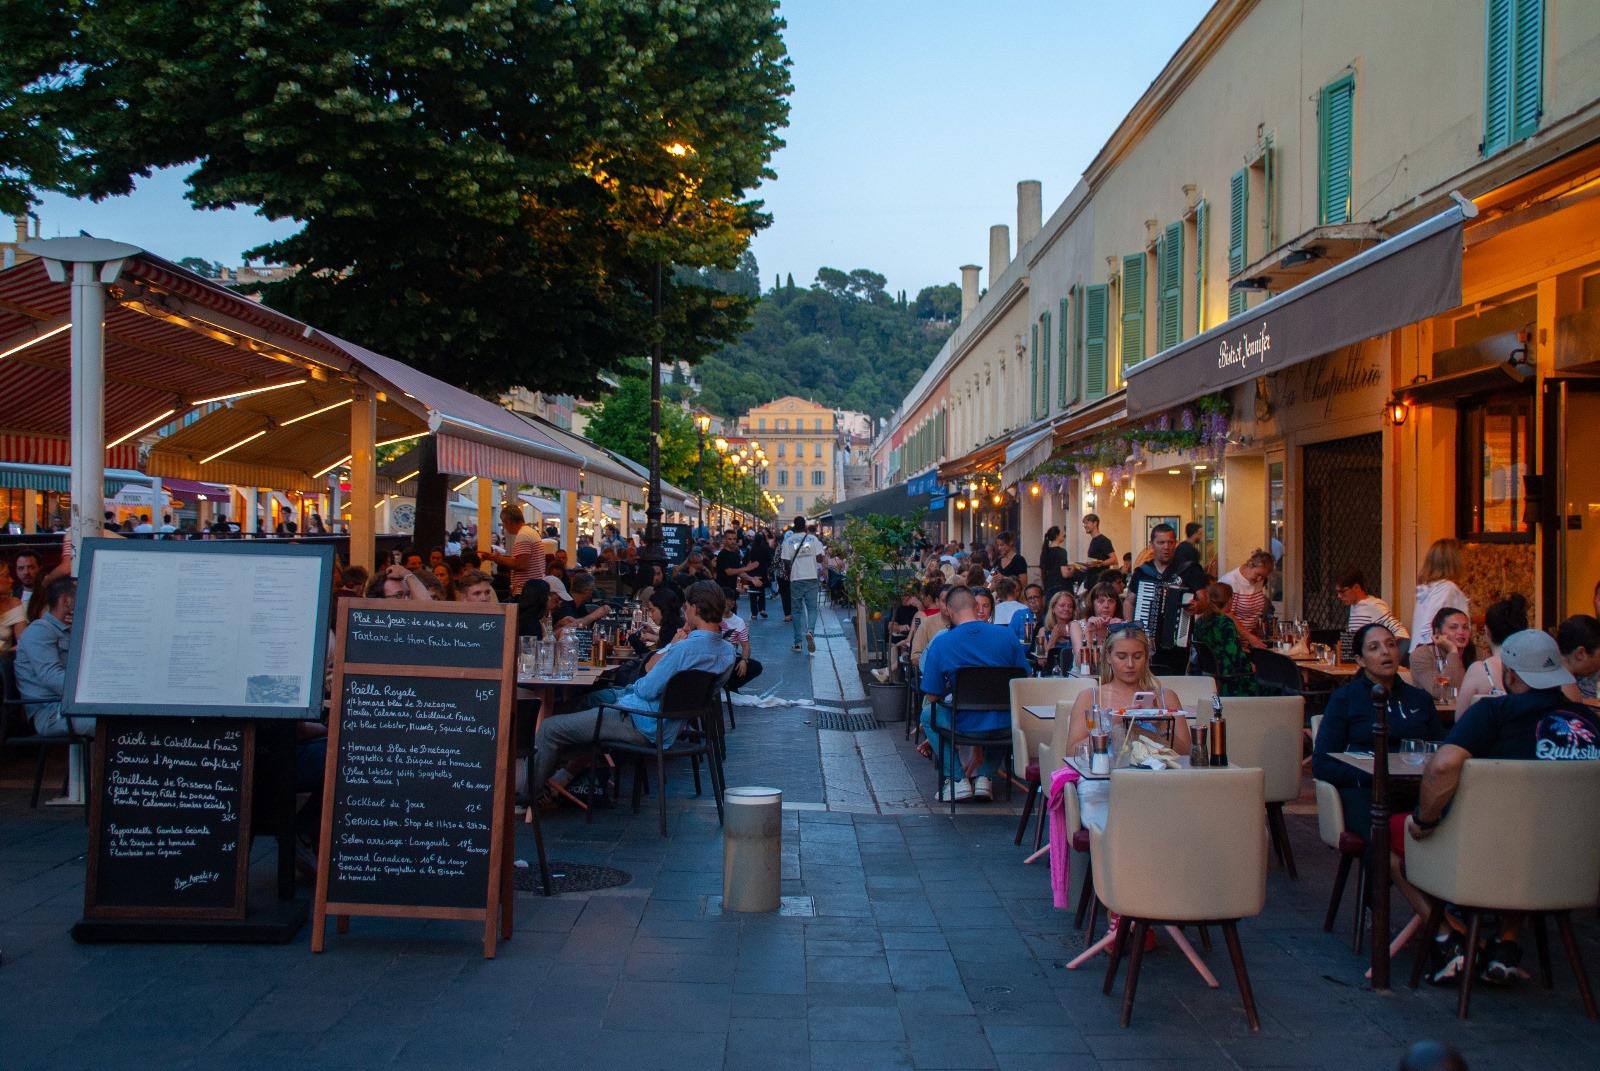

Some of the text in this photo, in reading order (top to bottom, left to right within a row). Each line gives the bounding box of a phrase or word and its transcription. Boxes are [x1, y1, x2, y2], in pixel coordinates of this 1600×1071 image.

[1218, 322, 1271, 369] Bistrot Jennifer
[374, 616, 386, 624] du
[411, 618, 422, 626] de
[478, 620, 496, 632] 15€
[351, 631, 392, 642] Tartare
[393, 633, 404, 643] de
[351, 681, 494, 702] Paëlla Royale 45€
[150, 736, 162, 746] de
[164, 736, 211, 750] Cabillaud
[213, 738, 238, 752] Frais
[348, 742, 383, 752] Homard
[409, 745, 418, 754] de
[116, 751, 150, 765] Souris
[437, 758, 447, 766] de
[164, 778, 176, 788] de
[346, 795, 386, 808] Cocktail
[465, 803, 483, 814] 12€
[424, 820, 434, 828] de
